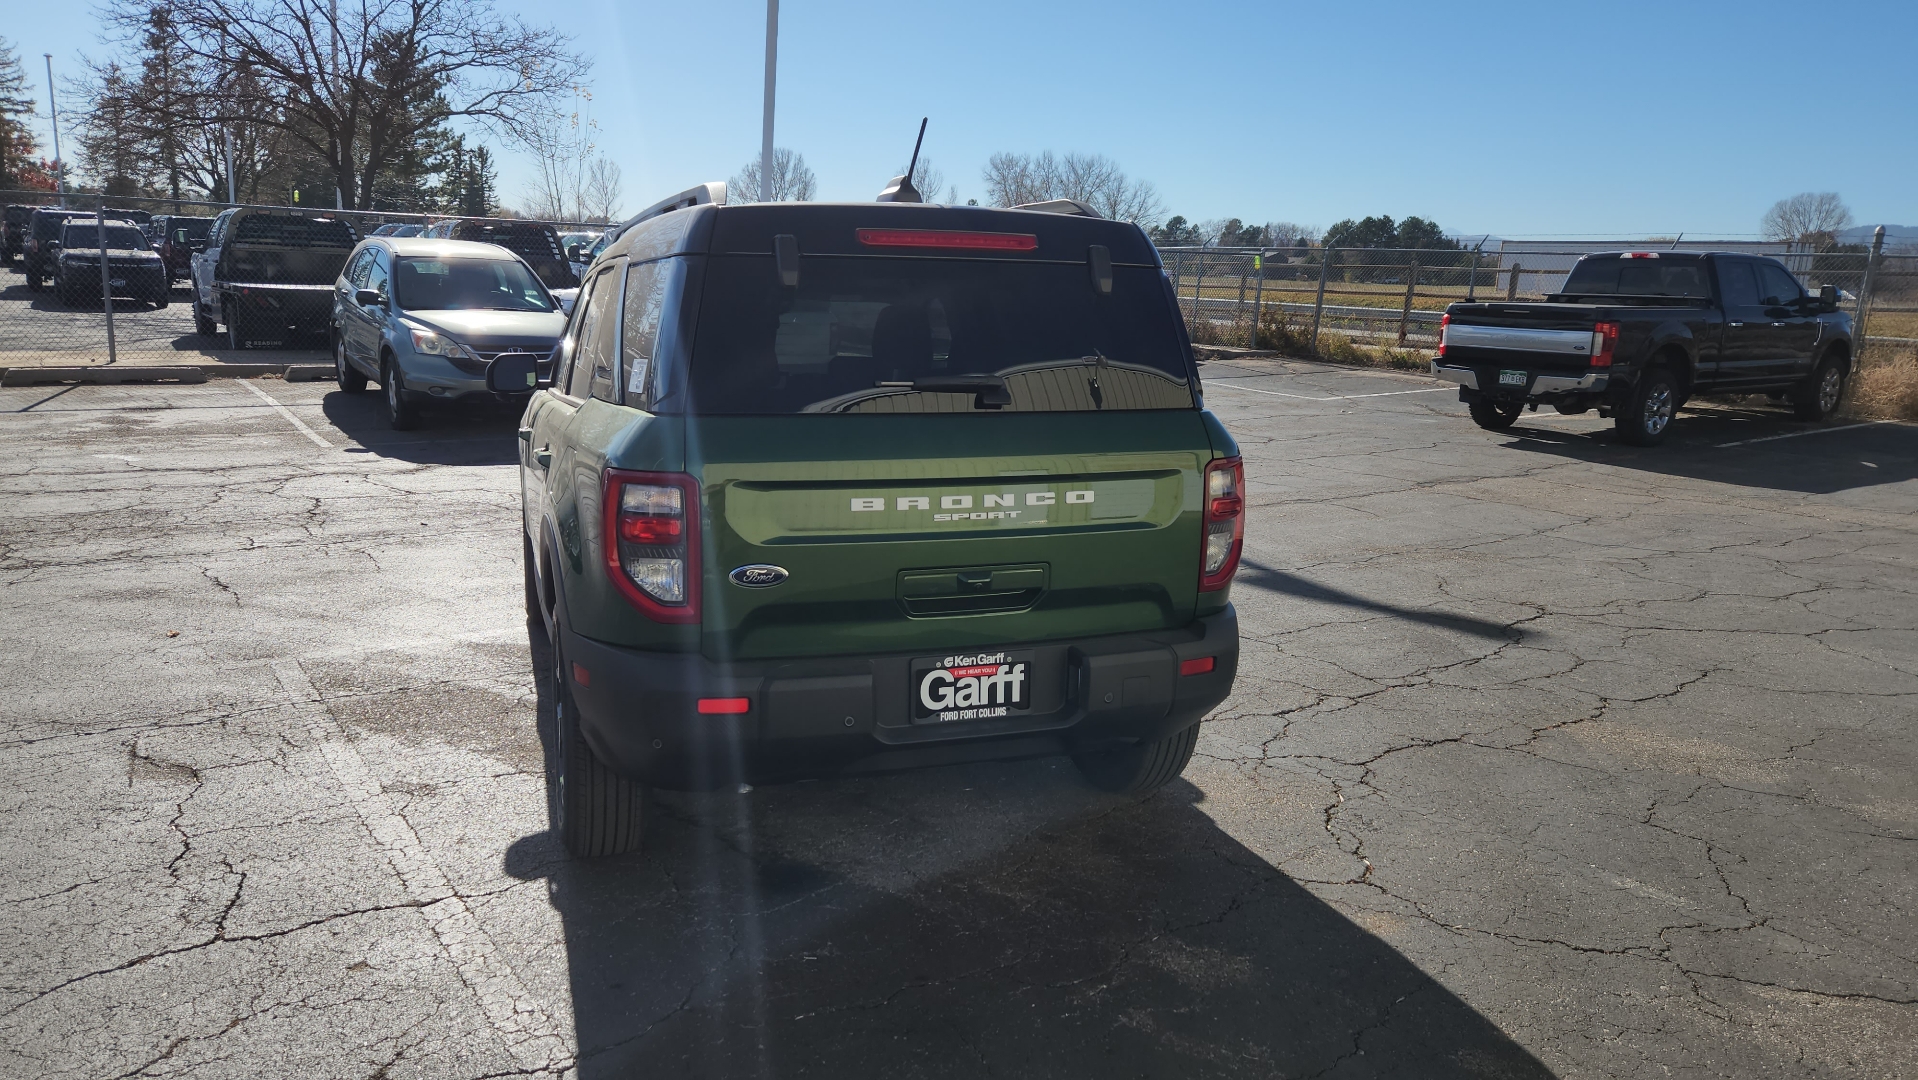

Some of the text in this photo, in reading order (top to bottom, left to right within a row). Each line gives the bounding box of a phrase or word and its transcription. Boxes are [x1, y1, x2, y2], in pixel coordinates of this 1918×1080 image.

[850, 490, 1095, 512] BRONCO
[933, 510, 1022, 522] SPORT
[743, 569, 775, 582] Ford
[954, 653, 1004, 667] Ken Garff
[920, 664, 1024, 710] Garff
[940, 707, 1006, 722] FORD FORT COLLINS
